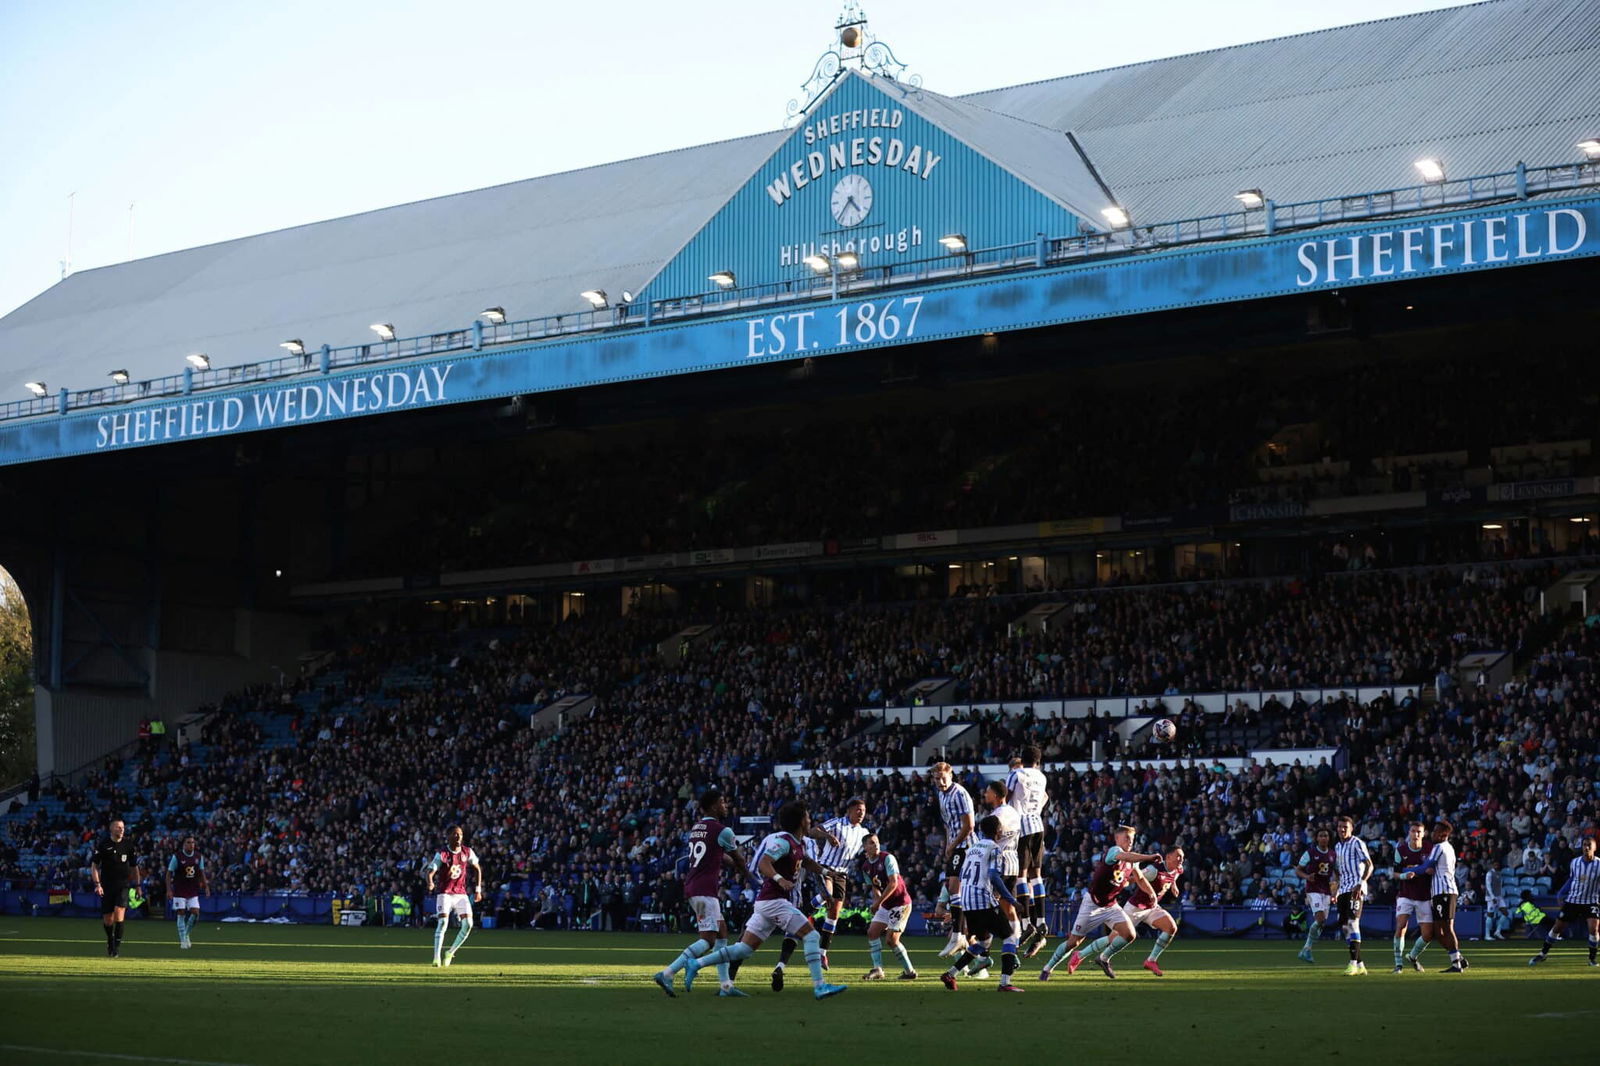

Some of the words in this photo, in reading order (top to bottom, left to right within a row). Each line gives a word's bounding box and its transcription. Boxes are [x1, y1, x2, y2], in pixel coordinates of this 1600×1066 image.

[804, 108, 903, 144] SHEFFIELD
[766, 136, 942, 207] WEDNESDAY
[780, 225, 923, 267] Hillsborough
[1296, 208, 1587, 287] SHEFFIELD
[746, 311, 819, 358] EST.
[835, 295, 925, 346] 1867
[95, 397, 244, 448] SHEFFIELD
[251, 364, 454, 424] WEDNESDAY
[952, 854, 961, 866] 8
[962, 861, 981, 886] 41
[889, 910, 901, 921] 24
